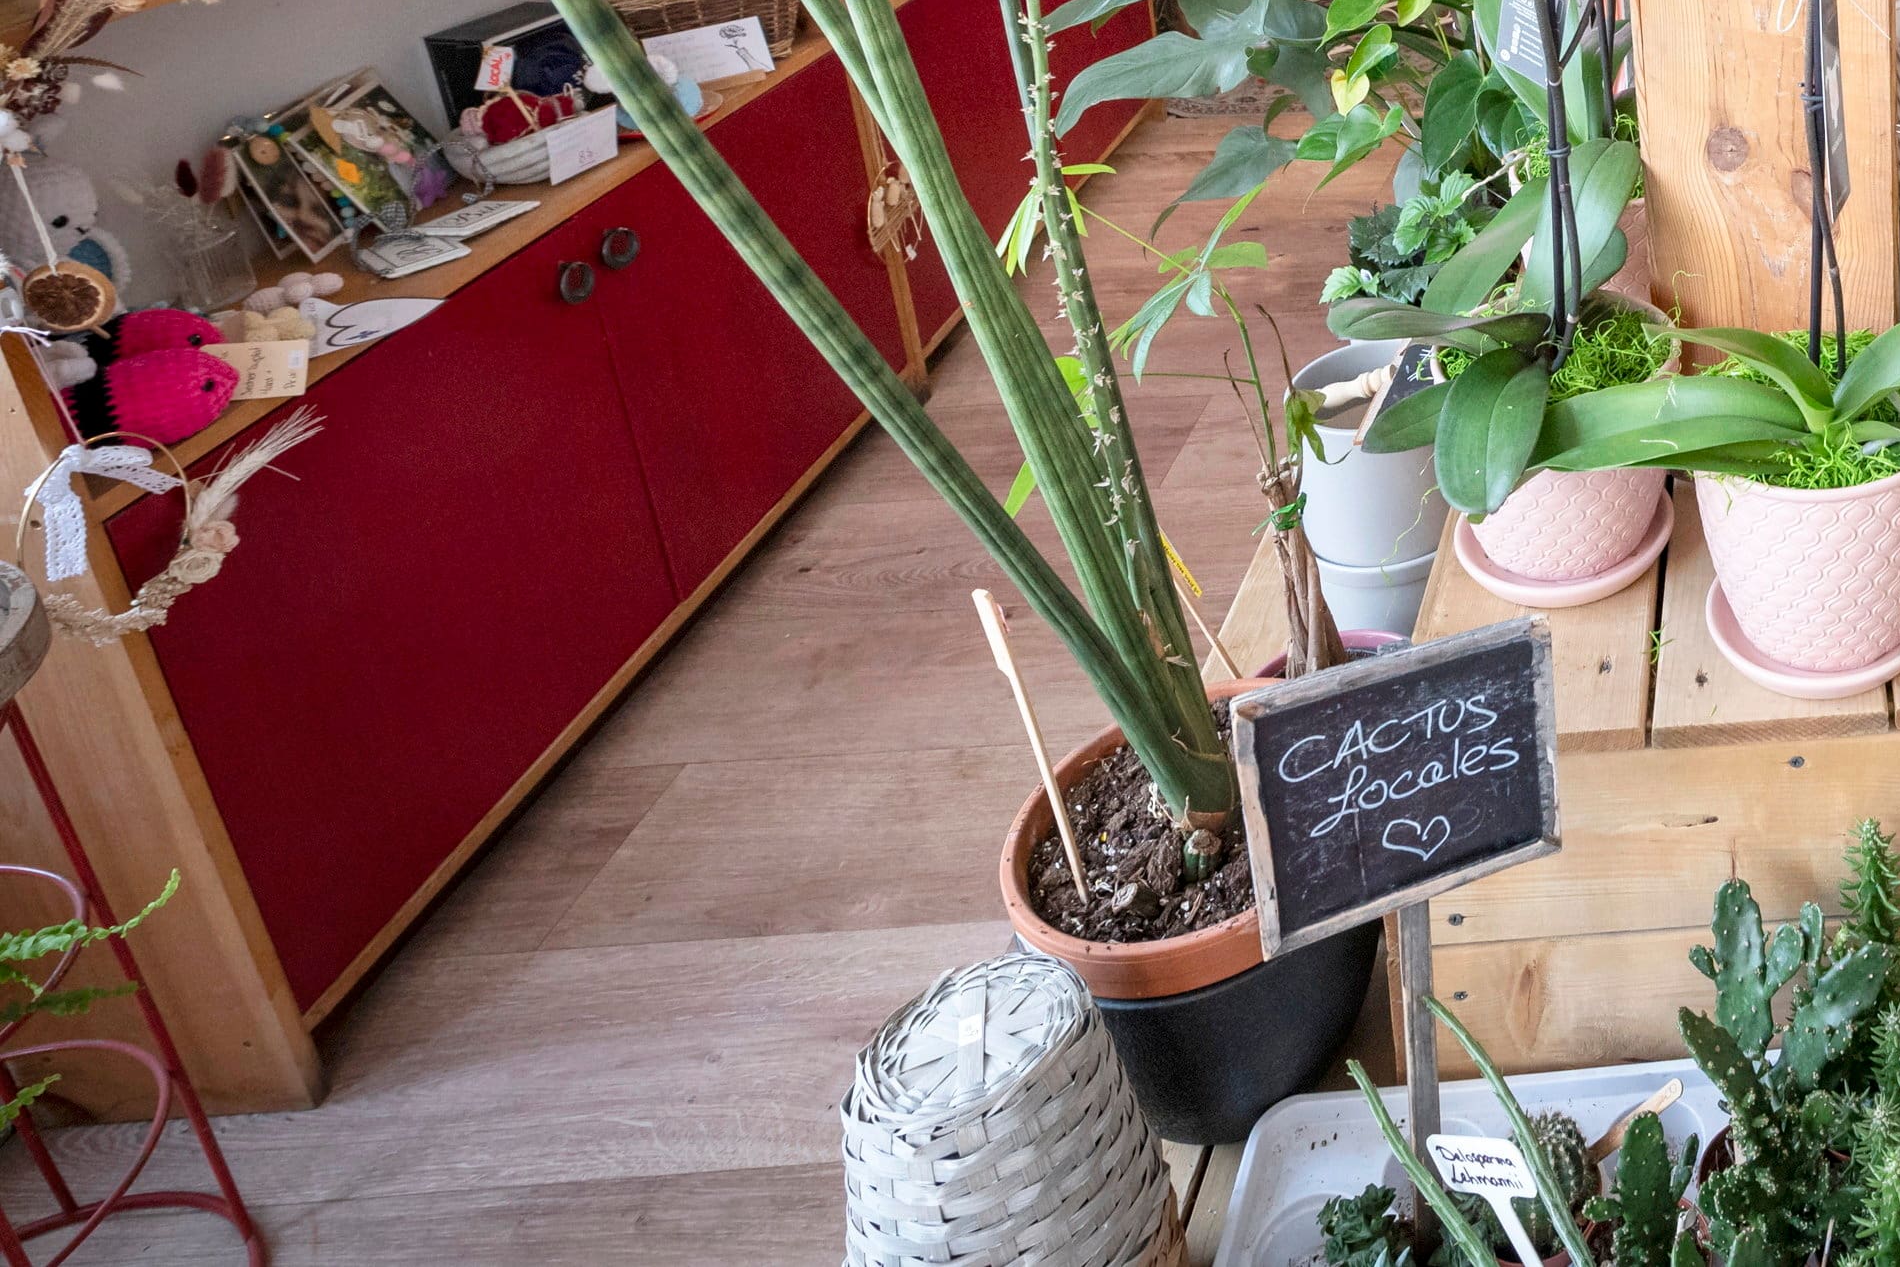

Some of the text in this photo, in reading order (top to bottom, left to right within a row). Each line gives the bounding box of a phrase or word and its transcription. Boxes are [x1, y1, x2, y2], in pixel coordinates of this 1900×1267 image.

[1277, 694, 1498, 783] CACTUS
[1310, 736, 1520, 837] Locales
[1435, 1144, 1516, 1168] Delosperma
